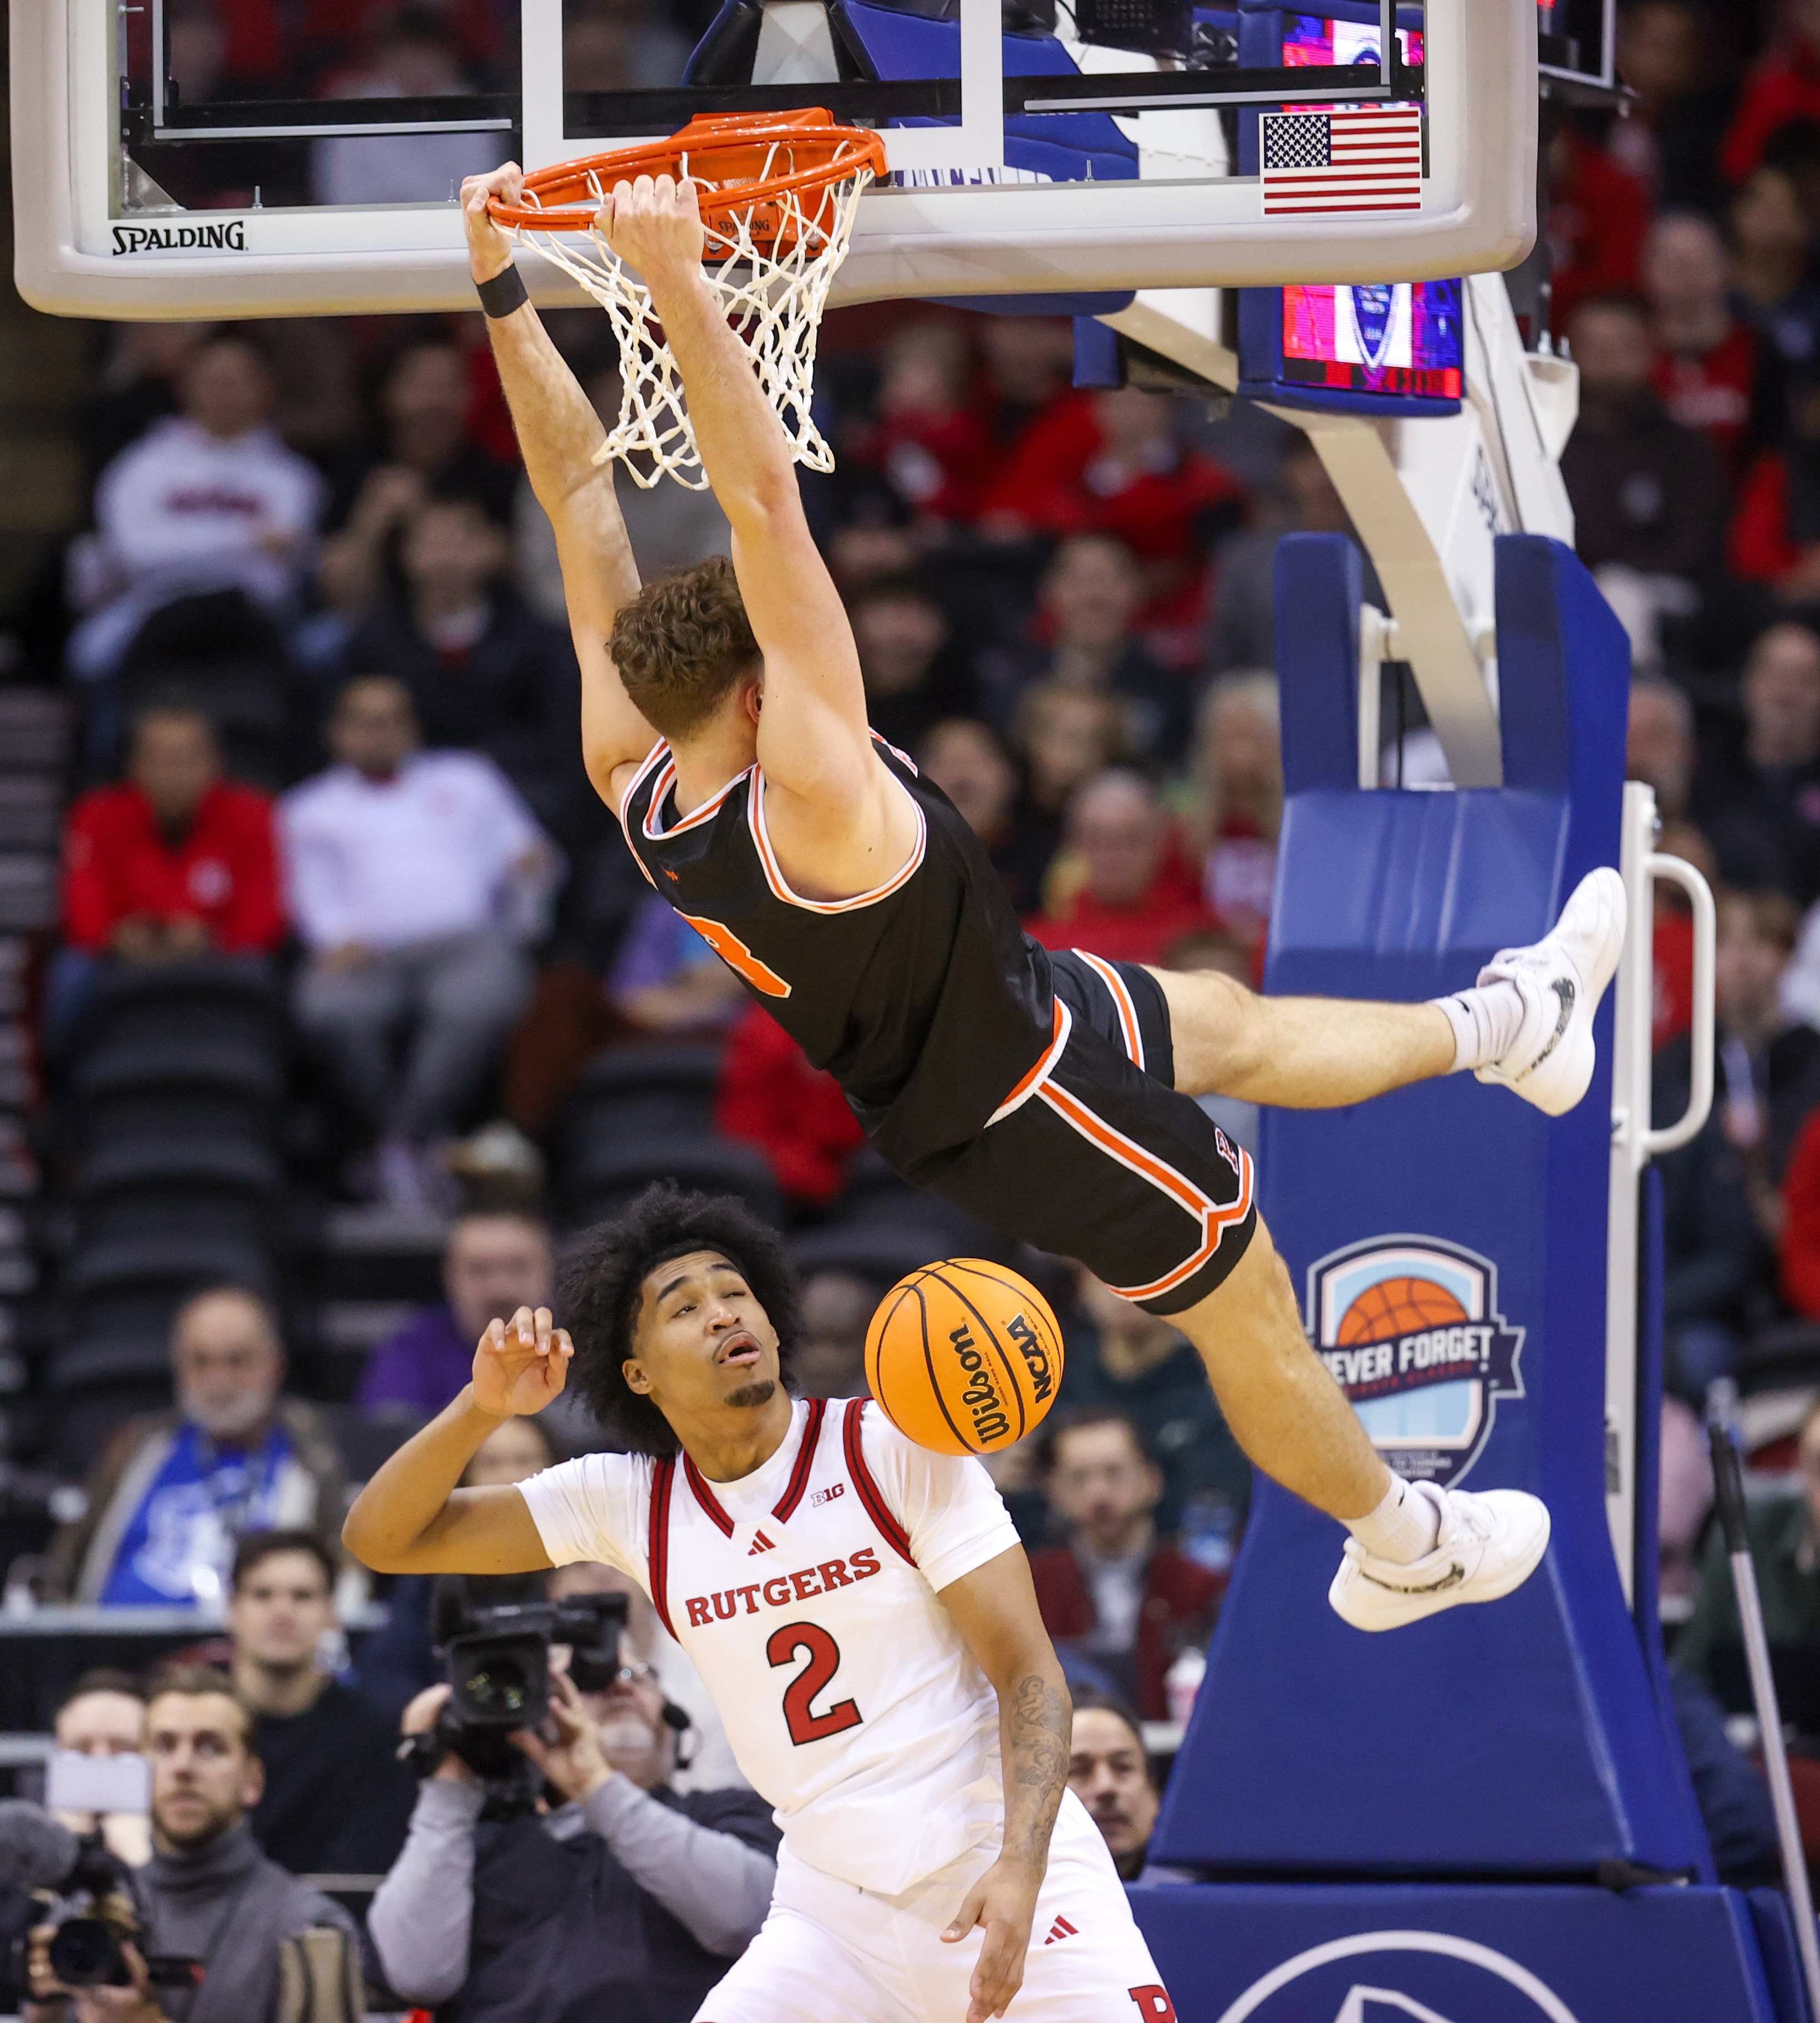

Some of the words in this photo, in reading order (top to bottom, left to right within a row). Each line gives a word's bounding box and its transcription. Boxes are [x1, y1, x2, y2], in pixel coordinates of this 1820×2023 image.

[113, 221, 244, 256] SPALDING
[949, 1323, 1010, 1445] Wilson
[1005, 1312, 1052, 1404] NCAA
[685, 1547, 881, 1627] RUTGERS
[766, 1621, 864, 1746] 2
